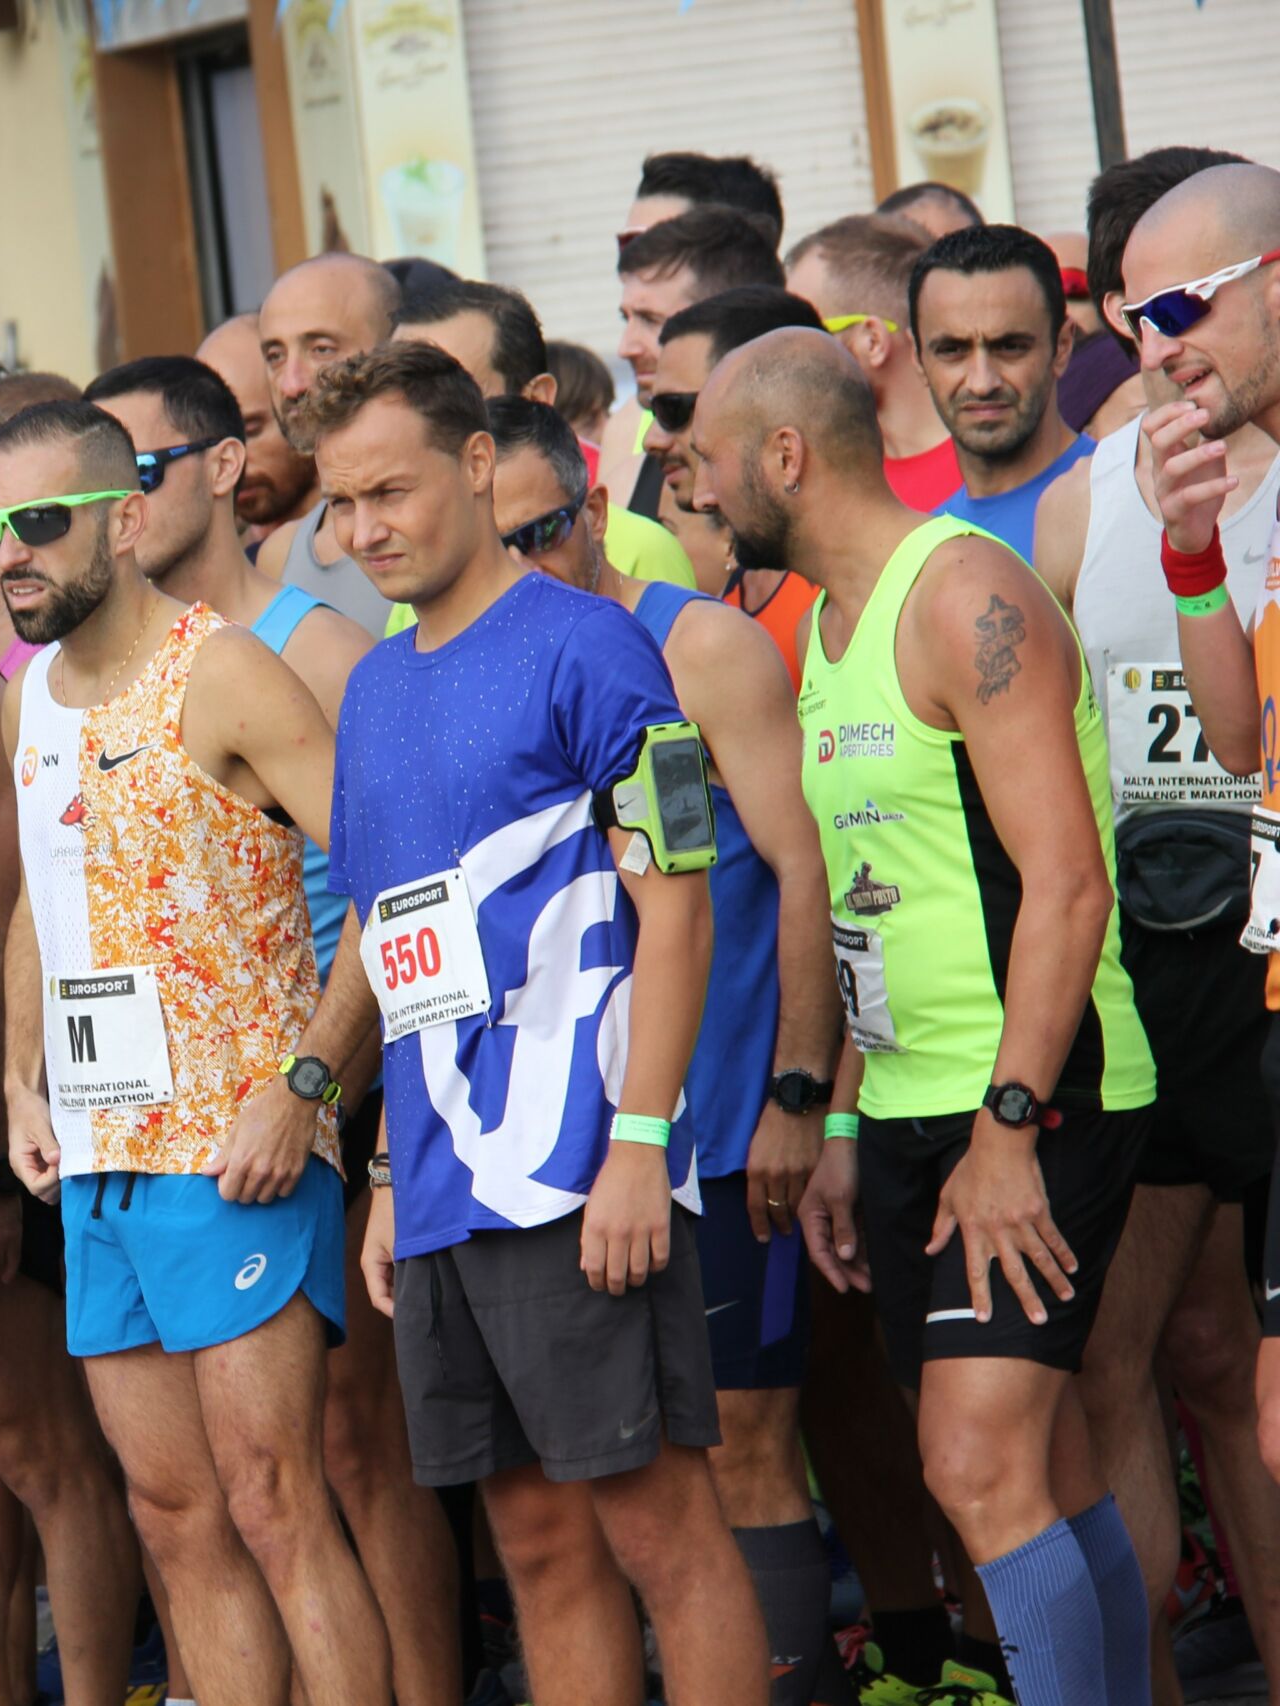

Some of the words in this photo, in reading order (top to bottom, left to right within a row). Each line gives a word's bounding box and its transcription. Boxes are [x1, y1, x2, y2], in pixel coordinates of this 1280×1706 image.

[839, 723, 894, 742] DIMECH
[42, 754, 59, 768] NN
[1123, 776, 1154, 786] MALTA
[1158, 775, 1259, 785] INTERNATIONAL
[1122, 790, 1186, 800] CHALLENGE
[1190, 789, 1262, 800] MARATHON
[391, 887, 443, 914] EUROSPORT
[380, 927, 441, 991] 550
[69, 980, 128, 995] EUROSPORT
[400, 989, 469, 1018] INTERNATIONAL
[419, 1003, 474, 1025] MARATHON
[67, 1015, 97, 1063] M
[73, 1079, 151, 1094] INTERNATIONAL
[88, 1092, 154, 1107] MARATHON
